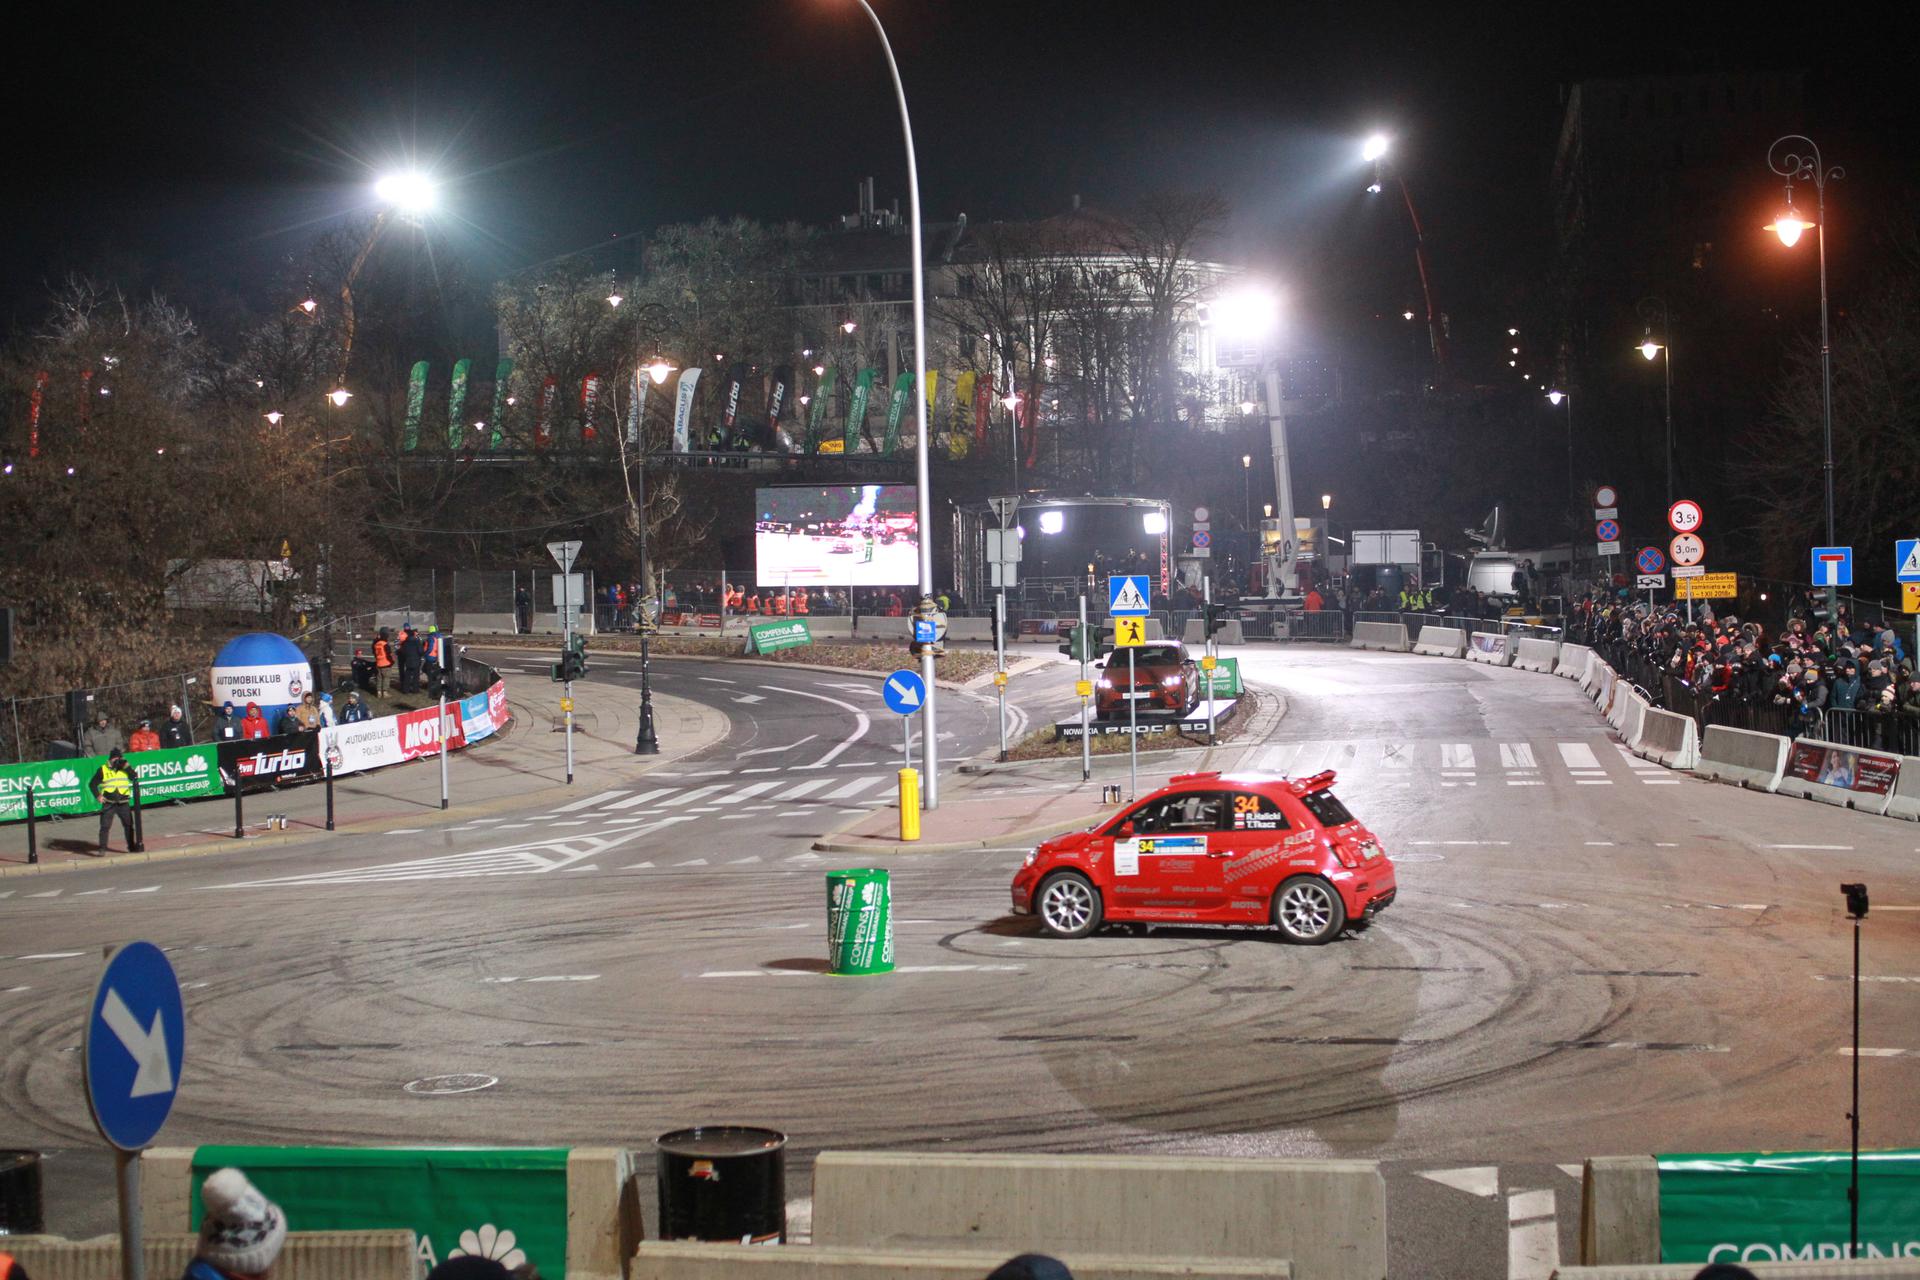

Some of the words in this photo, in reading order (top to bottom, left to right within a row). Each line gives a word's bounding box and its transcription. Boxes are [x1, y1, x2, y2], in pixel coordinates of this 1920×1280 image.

[676, 391, 688, 434] ABACUS
[756, 627, 792, 640] COMPENSA
[216, 674, 281, 685] AUTOMOBILKLUB
[232, 688, 261, 697] POLSKI
[185, 779, 210, 792] GROUP
[49, 796, 81, 808] GROUP
[1234, 796, 1259, 812] 34
[1246, 812, 1281, 821] R.Halicki
[1139, 840, 1155, 853] 34
